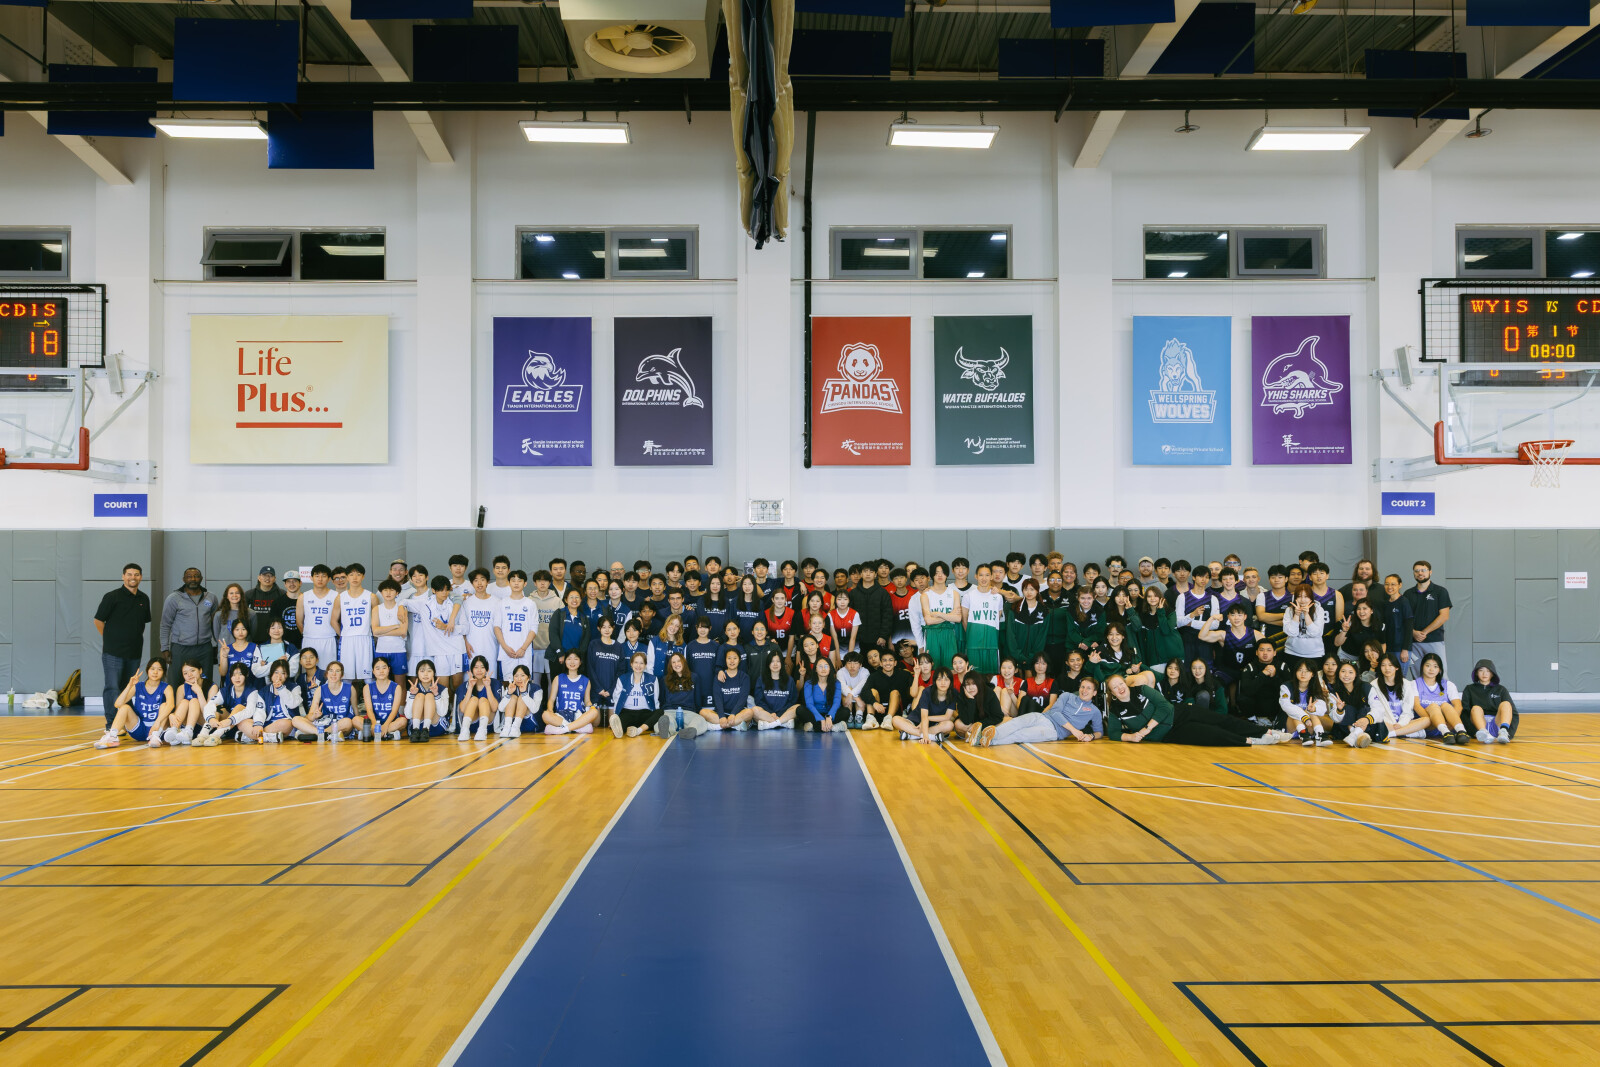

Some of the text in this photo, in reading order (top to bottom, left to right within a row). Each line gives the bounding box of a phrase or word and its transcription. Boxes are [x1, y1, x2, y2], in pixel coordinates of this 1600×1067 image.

[0, 303, 56, 317] CDIS
[1470, 299, 1529, 313] WYIS
[29, 329, 59, 356] 18
[1529, 343, 1576, 359] 08:00
[238, 346, 292, 376] Life
[511, 390, 575, 403] EAGLES
[622, 389, 681, 402] DOLPHINS
[830, 384, 892, 402] PANDAS
[942, 392, 1026, 404] WATER BUFFALOES
[1268, 389, 1328, 400] YHIS SHARKS
[1158, 394, 1208, 404] WELLSPRING
[1154, 403, 1211, 419] WOLVES
[104, 501, 138, 509] COURT 1
[1391, 499, 1426, 507] COURT 2
[310, 607, 329, 615] TIS
[346, 607, 366, 616] TIS
[470, 609, 491, 617] TIANJIN
[898, 608, 910, 621] 23
[972, 609, 998, 621] WYIS
[314, 616, 323, 625] 5
[349, 617, 363, 627] 10
[507, 613, 526, 622] TIS
[509, 622, 523, 632] 16
[776, 629, 786, 639] 16
[840, 627, 847, 638] 11
[563, 690, 581, 701] TIS
[707, 695, 713, 705] 2
[140, 702, 160, 712] TIS
[326, 704, 347, 714] TIS
[373, 702, 392, 711] TIS
[563, 700, 578, 711] 13
[378, 711, 388, 720] 7
